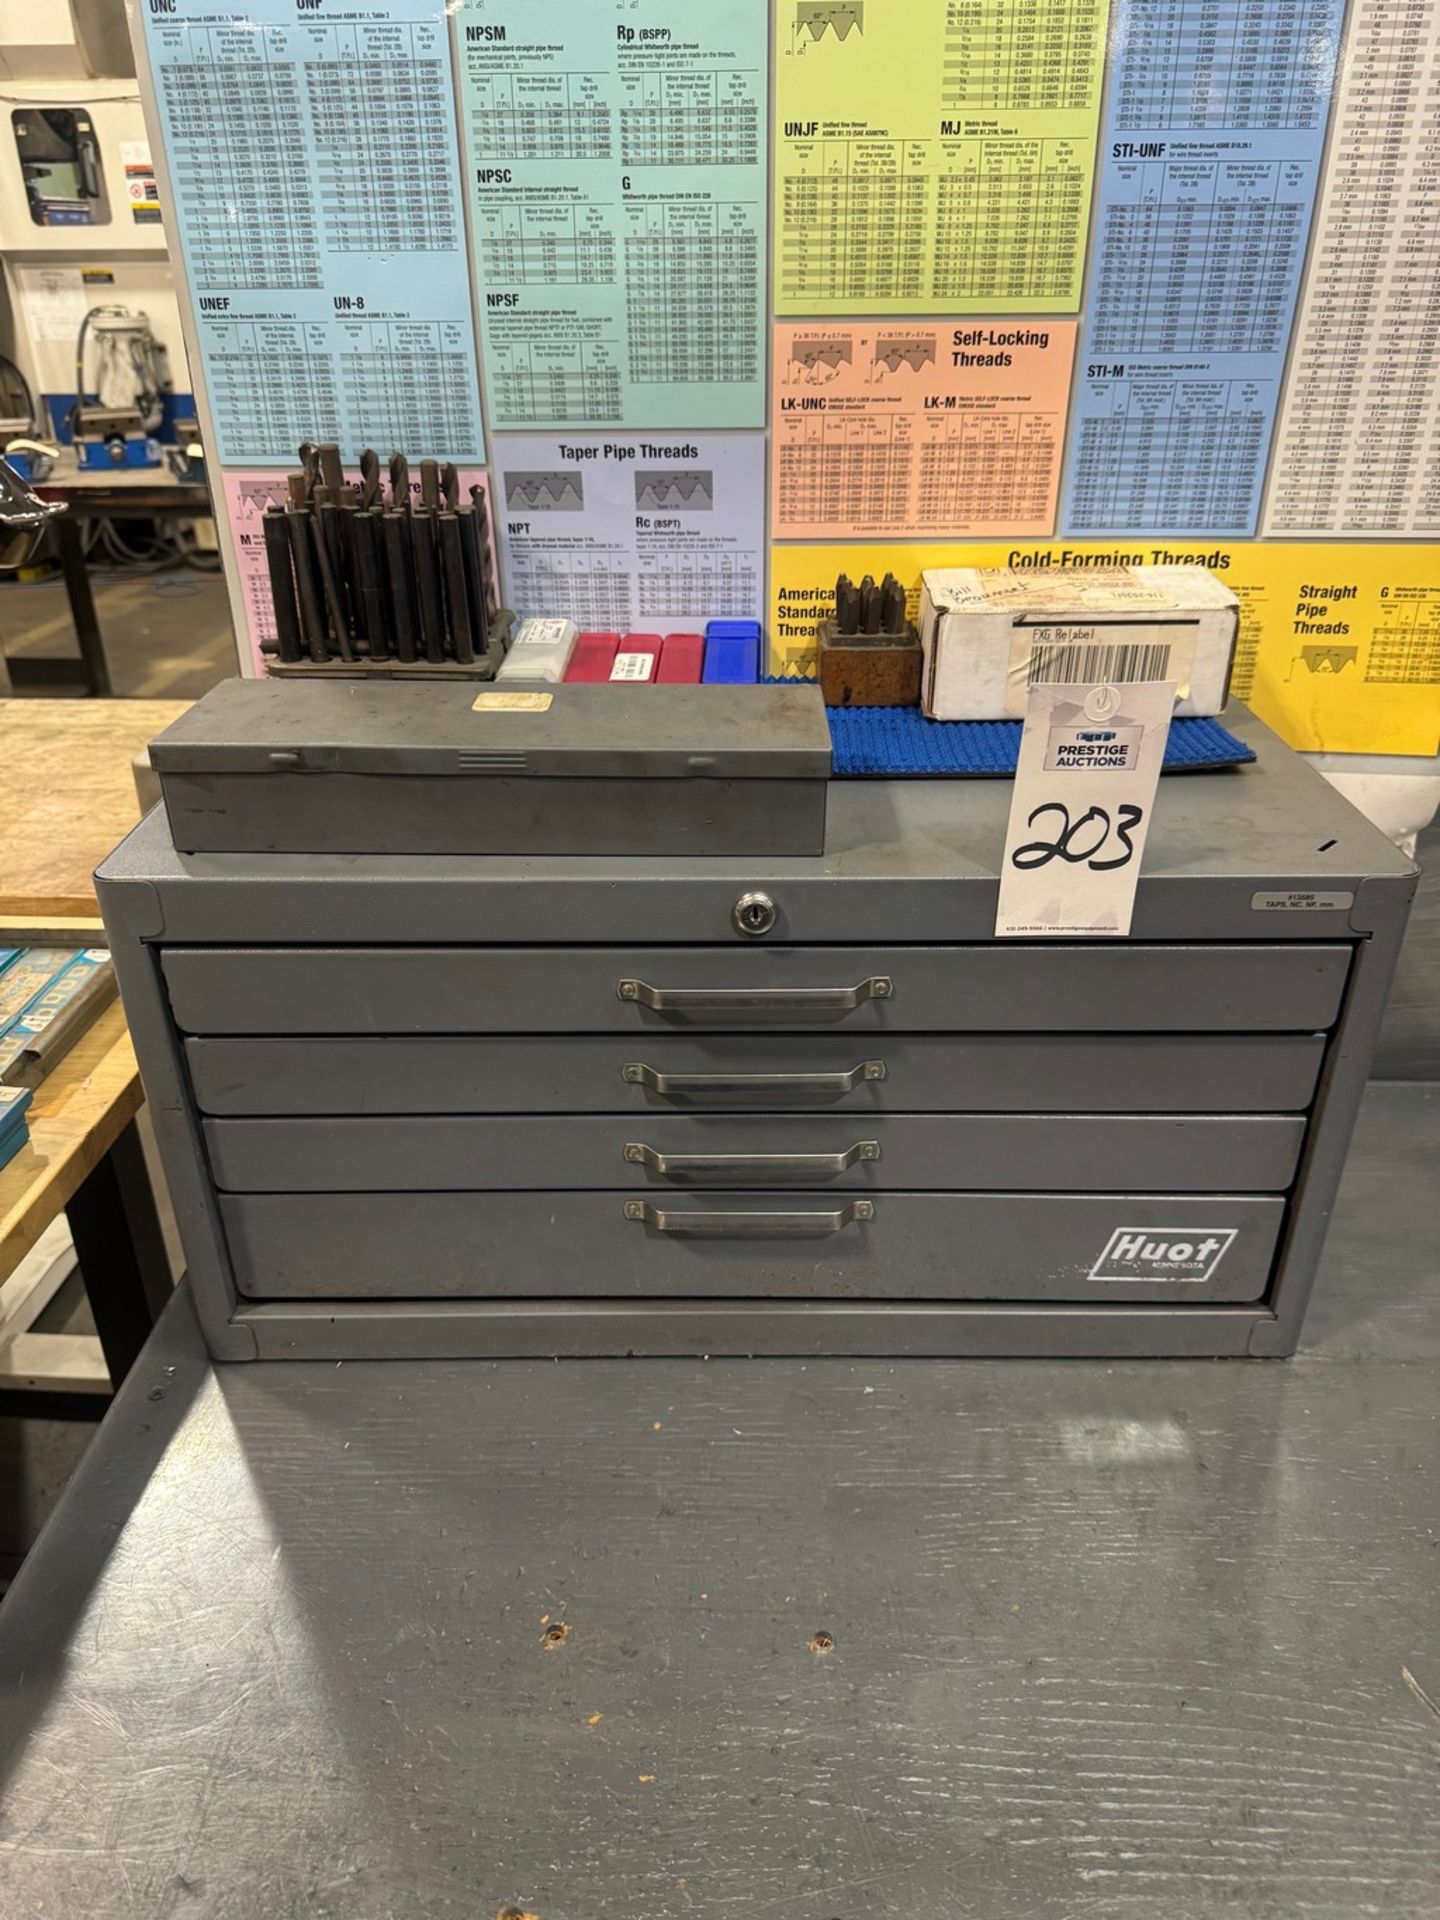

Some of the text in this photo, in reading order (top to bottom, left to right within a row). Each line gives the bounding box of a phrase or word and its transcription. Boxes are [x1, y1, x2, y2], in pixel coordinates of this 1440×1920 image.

[466, 26, 506, 41] NPSM
[617, 25, 671, 42] Rp (BSPP)
[784, 122, 818, 137] UNJF
[941, 120, 961, 135] MJ
[1113, 143, 1166, 158] STI-UNF
[477, 169, 512, 184] NPSC
[622, 176, 631, 190] G
[199, 297, 230, 310] UNEF
[334, 296, 364, 310] UN-8
[487, 294, 520, 307] NPSF
[953, 330, 1049, 348] Self-Locking
[952, 352, 1012, 367] Threads
[1087, 364, 1124, 378] STI-M
[781, 398, 826, 410] LK-UNC
[924, 396, 956, 409] LK-M
[559, 444, 698, 462] Taper Pipe Threads
[508, 523, 531, 534] NPT
[636, 517, 681, 529] Rc (BSPT)
[240, 534, 251, 545] M
[1008, 550, 1230, 569] Cold-Forming Threads
[778, 588, 834, 600] America
[1299, 585, 1357, 600] Straight
[1380, 587, 1389, 598] G
[778, 606, 837, 618] Standar
[1296, 603, 1327, 618] Pipe
[778, 624, 815, 636] Threa
[1033, 628, 1094, 641] FXG Relabel
[1293, 621, 1350, 635] Threads
[1058, 745, 1128, 755] PRESTIGE
[1056, 756, 1126, 767] AUCTIONS
[1012, 802, 1142, 871] 203
[1110, 1235, 1220, 1261] Huot
